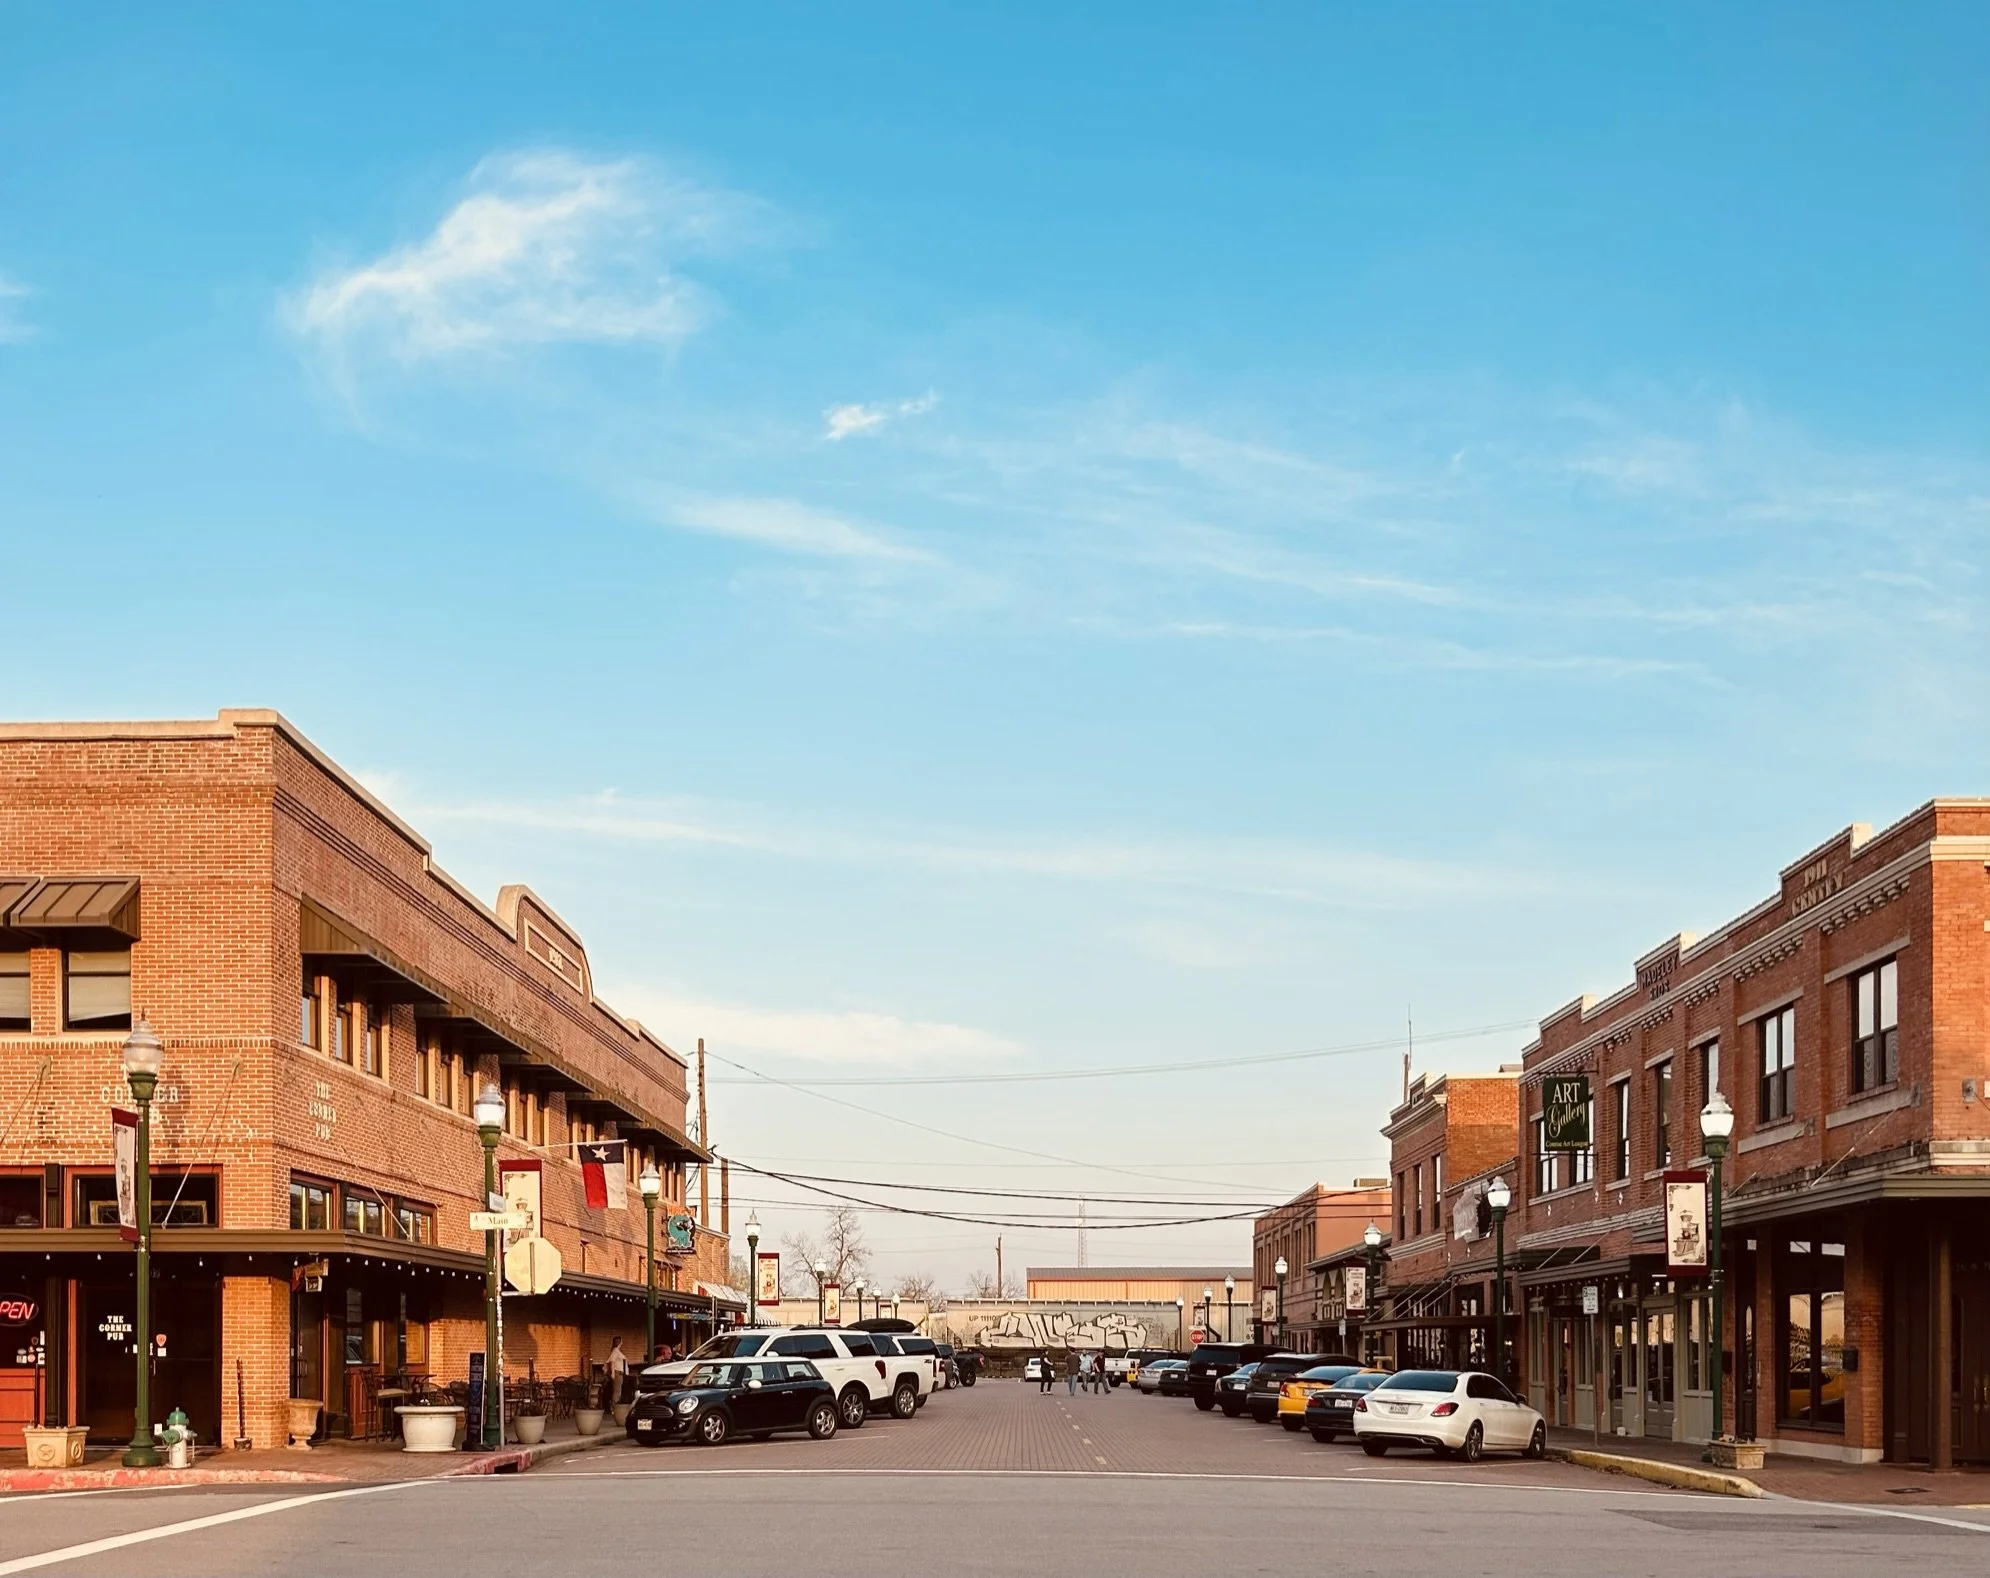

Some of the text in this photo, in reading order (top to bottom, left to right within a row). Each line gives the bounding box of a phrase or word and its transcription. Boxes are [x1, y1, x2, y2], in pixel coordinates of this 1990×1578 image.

[100, 1086, 179, 1103] COER
[1552, 1082, 1581, 1104] ART
[1546, 1102, 1586, 1138] Gallery
[488, 1216, 509, 1225] Main
[0, 1301, 35, 1319] PEN
[107, 1315, 124, 1324] THE
[98, 1323, 133, 1332] CORNER
[107, 1332, 124, 1341] PUB
